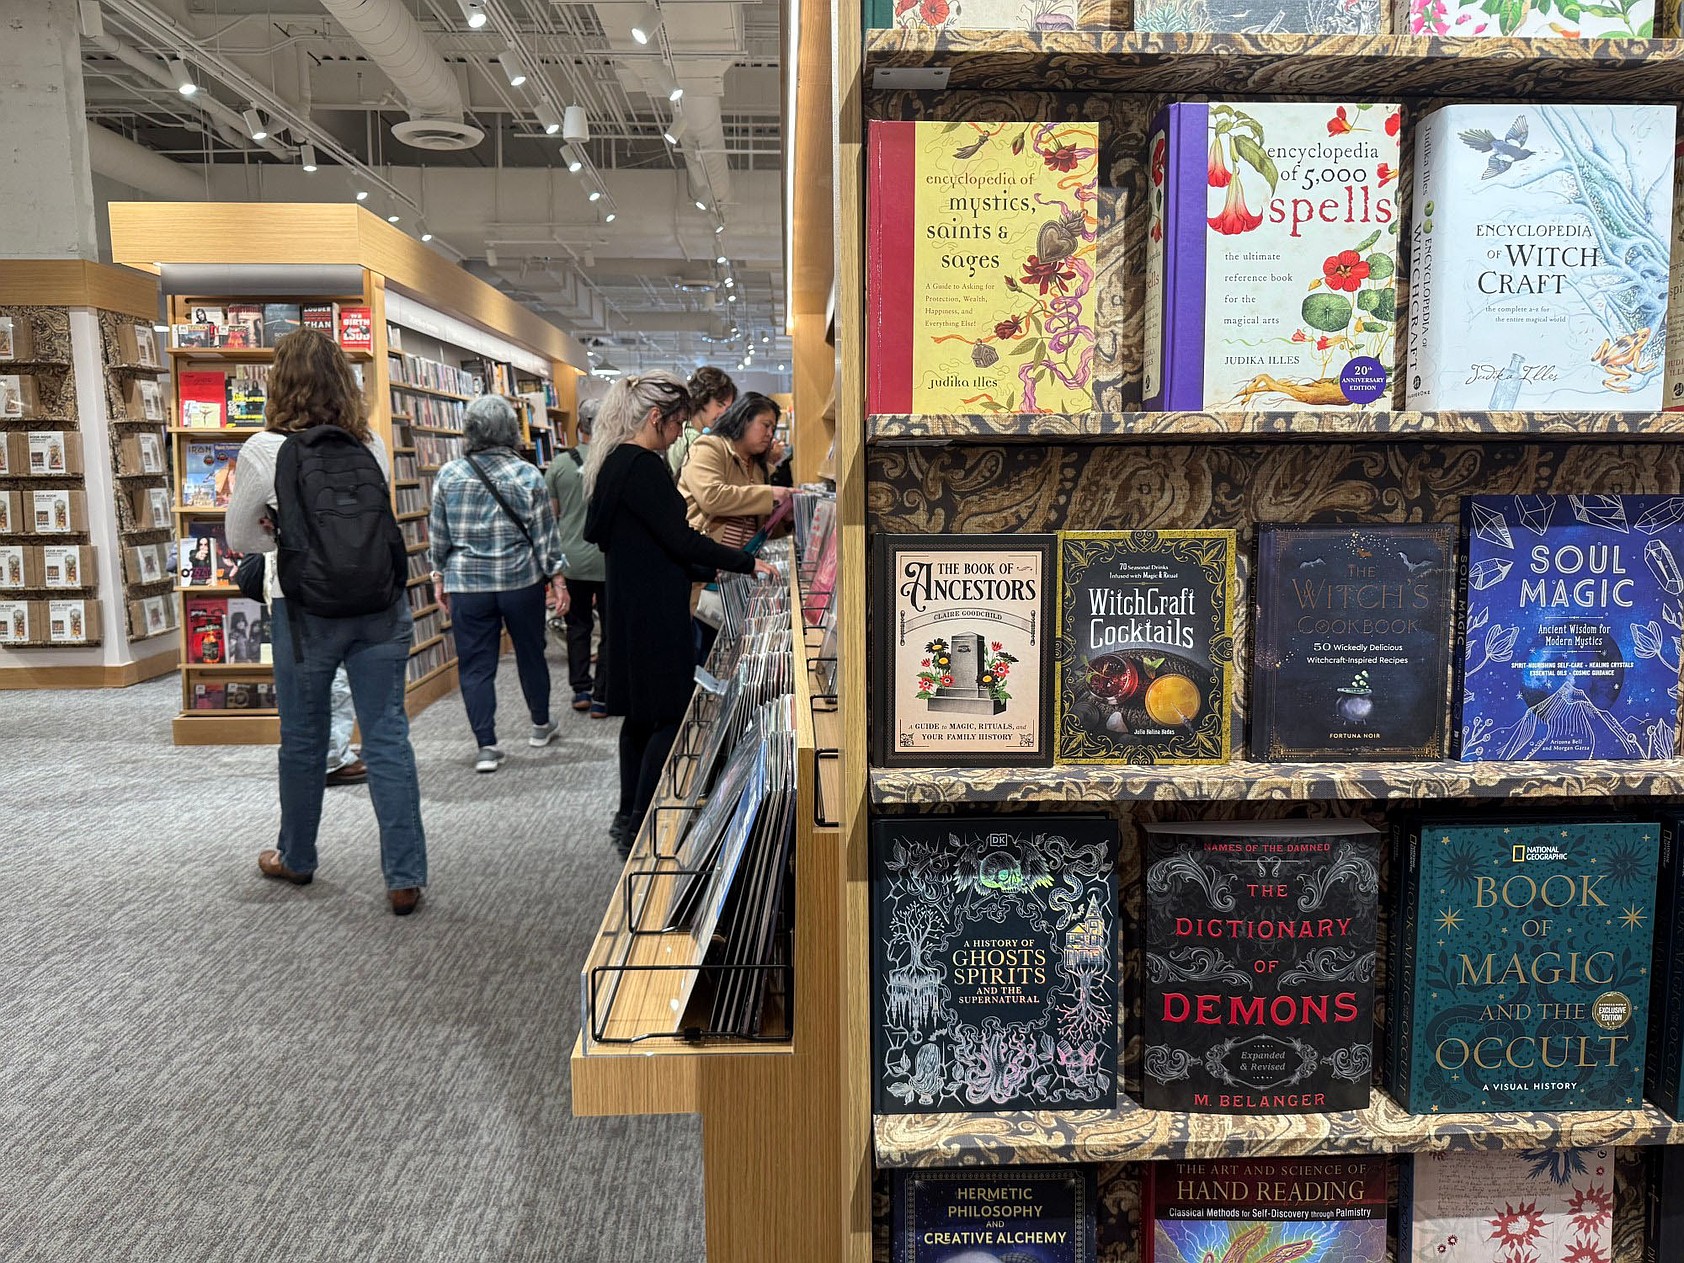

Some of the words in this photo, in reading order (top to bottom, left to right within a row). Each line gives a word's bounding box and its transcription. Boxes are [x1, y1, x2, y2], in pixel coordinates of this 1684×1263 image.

[1268, 143, 1379, 163] encyclopedia
[926, 173, 1016, 188] encyclopedia
[1020, 173, 1035, 185] of
[1281, 165, 1300, 181] of
[1302, 169, 1366, 190] 5,000
[950, 190, 1036, 218] mystics,
[1269, 186, 1392, 237] spells
[927, 218, 991, 239] saints
[998, 226, 1007, 238] &
[1476, 225, 1592, 237] ENCYCLOPEDIA
[1225, 253, 1239, 261] the
[1243, 252, 1280, 261] ultimate
[1487, 250, 1501, 259] OF
[1505, 244, 1598, 267] WITCH
[941, 254, 999, 277] sages
[1225, 273, 1267, 282] reference
[1271, 273, 1293, 281] book
[1478, 271, 1567, 294] CRAFT
[932, 282, 951, 290] Guide
[962, 282, 982, 292] Asking
[985, 282, 994, 290] for
[1421, 238, 1432, 336] ENCYCLOPEDIA
[925, 295, 961, 303] Protection,
[964, 295, 987, 303] Wealth,
[1224, 295, 1238, 303] for
[1242, 295, 1256, 303] the
[1410, 224, 1422, 370] WITCHCRAFT
[925, 307, 959, 316] Happiness,
[925, 320, 958, 328] Everything
[1224, 316, 1259, 326] magical
[1526, 316, 1547, 325] magical
[1224, 357, 1265, 365] JUDIKA
[1465, 364, 1513, 384] Judika
[1519, 365, 1558, 382] Illes
[1530, 545, 1626, 574] SOUL
[938, 563, 959, 575] THE
[964, 563, 995, 574] BOOK
[1000, 563, 1014, 574] OF
[1349, 564, 1376, 577] THE
[1458, 555, 1467, 592] SOUL
[901, 562, 1036, 612] ANCESTORS
[1292, 578, 1429, 609] WITCH'S
[1519, 579, 1634, 608] MAGIC
[1088, 588, 1195, 616] WitchCraft
[934, 611, 959, 620] CLAIRE
[961, 611, 1002, 620] GOODCHILD
[1298, 616, 1420, 635] COOKBOOK
[1457, 601, 1465, 646] MAGIC
[1538, 624, 1567, 634] Ancient
[1569, 624, 1596, 634] Wisdom
[1598, 624, 1610, 634] for
[1090, 618, 1194, 649] Cocktails
[1313, 643, 1331, 651] 50
[1333, 643, 1368, 652] Wickedly
[1370, 643, 1402, 651] Delicious
[1545, 636, 1572, 646] Modern
[1574, 636, 1602, 648] Mystics
[1307, 656, 1378, 665] Witchcraft-Inspired
[1379, 656, 1408, 665] Recipes
[992, 836, 1006, 844] DK
[1204, 843, 1242, 852] NAMES
[1261, 844, 1284, 852] THE
[1287, 843, 1331, 852] DAMNED
[1527, 846, 1559, 854] NATIONAL
[1247, 884, 1288, 898] THE
[1473, 875, 1609, 909] BOOK
[1175, 918, 1352, 939] DICTIONARY
[1522, 919, 1553, 936] OF
[952, 950, 1046, 967] GHOSTS
[1254, 960, 1278, 973] OF
[1457, 951, 1615, 986] MAGIC
[954, 967, 1046, 985] SPIRITS
[976, 987, 998, 995] AND
[1001, 987, 1022, 995] THE
[958, 996, 1040, 1004] SUPERNATURAL
[1161, 992, 1358, 1026] DEMONS
[1479, 1004, 1531, 1021] AND
[1538, 1004, 1586, 1020] THE
[1601, 1013, 1622, 1021] EDITION
[1241, 1052, 1285, 1061] Expanded
[1435, 1036, 1629, 1070] OCCULT
[1240, 1063, 1247, 1071] &
[1250, 1063, 1285, 1071] Revised
[1533, 1082, 1577, 1090] HISTORY
[1194, 1094, 1211, 1106] M.
[1220, 1093, 1326, 1107] BELANGER
[1177, 1164, 1205, 1174] THE
[1211, 1165, 1238, 1175] ART
[1244, 1165, 1275, 1175] AND
[1281, 1165, 1342, 1176] SCIENCE
[1348, 1164, 1366, 1174] OF
[958, 1187, 1033, 1202] HERMETIC
[1177, 1180, 1248, 1200] HAND
[1257, 1181, 1365, 1201] READING
[948, 1206, 1043, 1217] PHILOSOPHY
[1169, 1208, 1204, 1217] Classical
[1207, 1208, 1239, 1217] Methods
[1252, 1208, 1309, 1219] Self-Discovery
[1311, 1210, 1334, 1219] through
[1336, 1208, 1371, 1219] Palmistry
[924, 1232, 993, 1245] CREATIVE
[997, 1232, 1067, 1244] ALCHEMY
